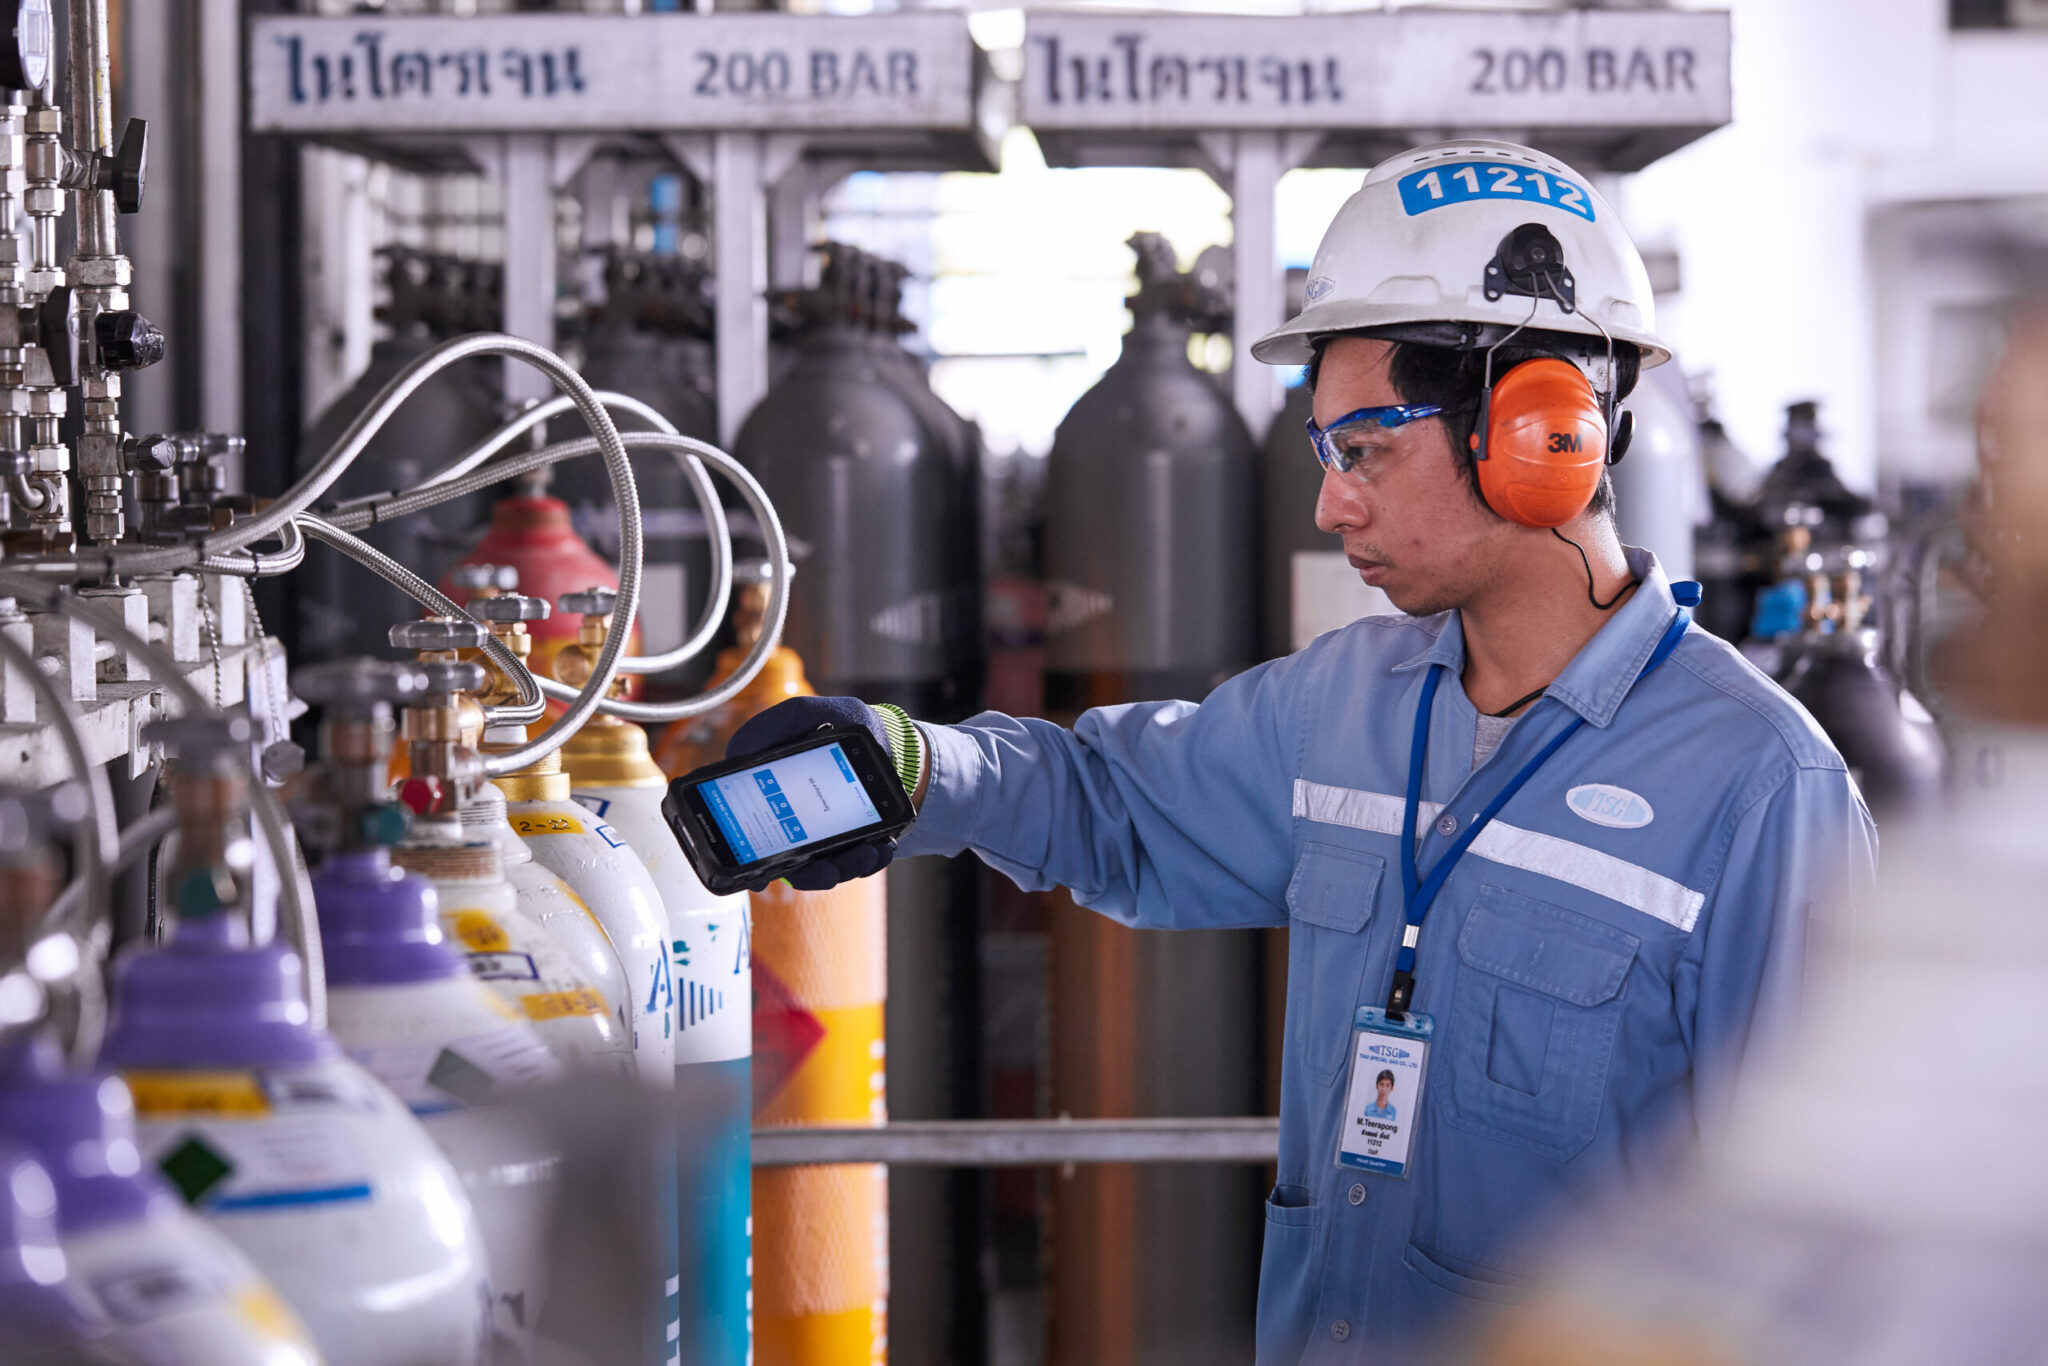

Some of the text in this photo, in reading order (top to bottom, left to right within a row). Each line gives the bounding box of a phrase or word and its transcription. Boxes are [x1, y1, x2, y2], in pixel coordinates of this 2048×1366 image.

[275, 31, 919, 101] ไนโตรเจน 200 BAR
[1033, 34, 1697, 101] ไนโตรเจน 200 BAR
[1416, 166, 1587, 214] 11212
[1548, 433, 1583, 453] 3M
[1380, 1045, 1399, 1058] TSG
[1357, 1117, 1398, 1134] M.Teerapong
[1367, 1138, 1383, 1148] 11212
